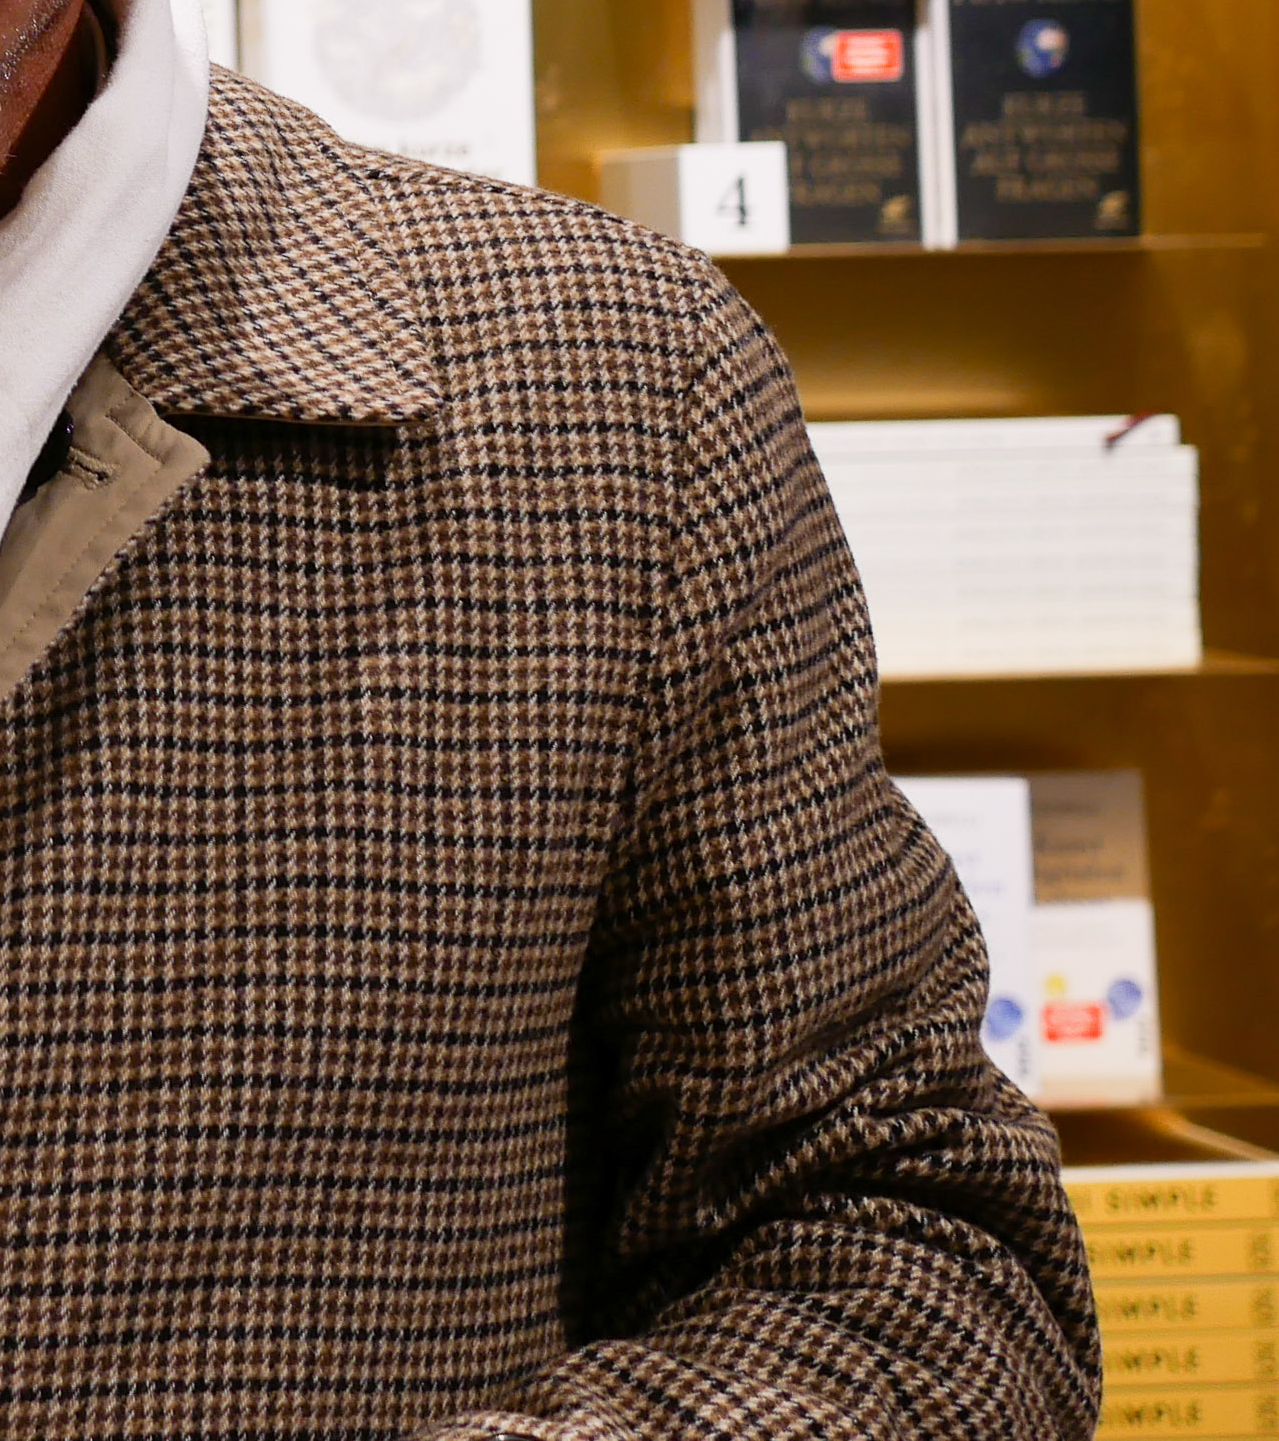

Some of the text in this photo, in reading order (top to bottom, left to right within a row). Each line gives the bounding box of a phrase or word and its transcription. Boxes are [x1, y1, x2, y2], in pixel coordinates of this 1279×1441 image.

[716, 174, 751, 228] 4
[1104, 1182, 1215, 1213] SIMPLE
[1101, 1344, 1200, 1375] IMPLE
